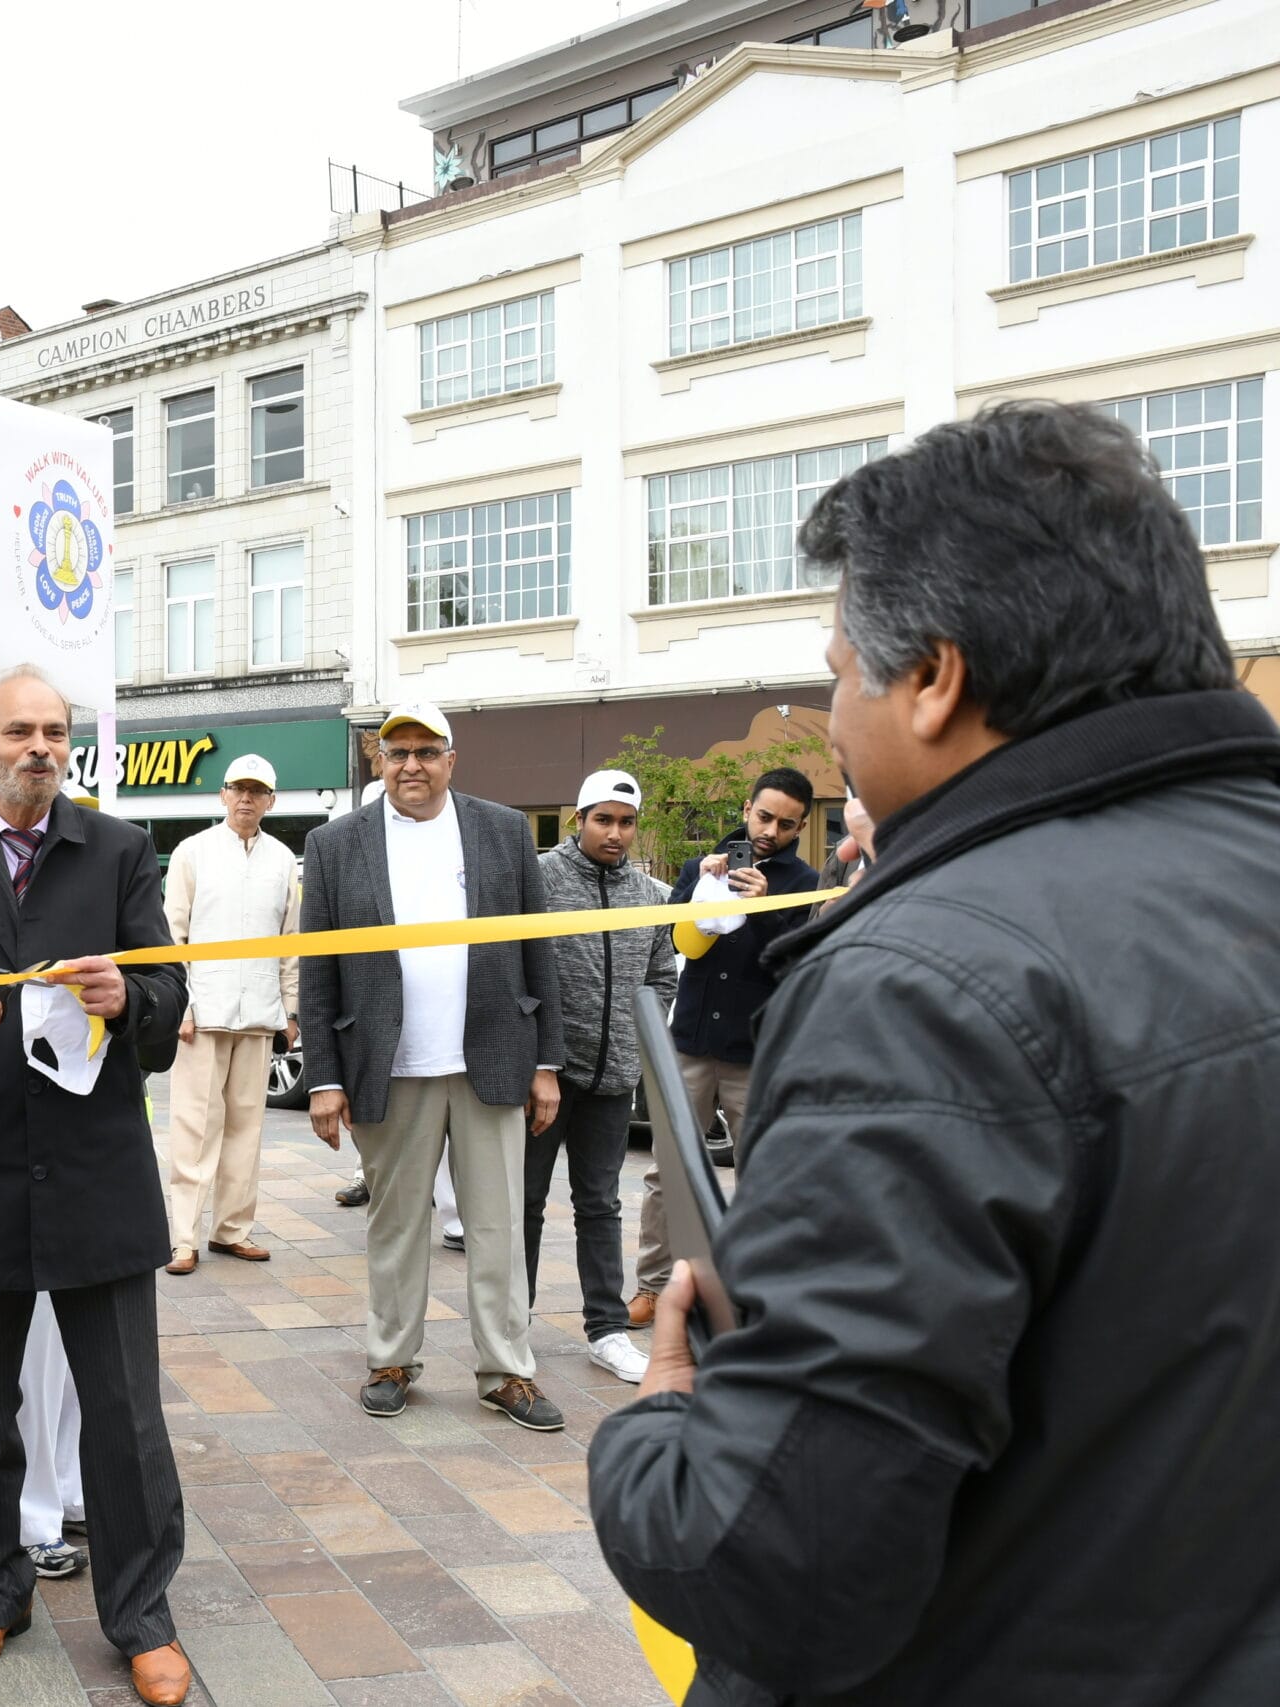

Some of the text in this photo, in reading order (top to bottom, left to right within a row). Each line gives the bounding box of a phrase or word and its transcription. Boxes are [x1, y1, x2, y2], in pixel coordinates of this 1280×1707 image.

[38, 286, 266, 367] CAMPION CHAMBERS
[25, 451, 108, 518] WALK WITH VALUES
[56, 492, 78, 509] TRUTH
[40, 574, 56, 602] LOVE
